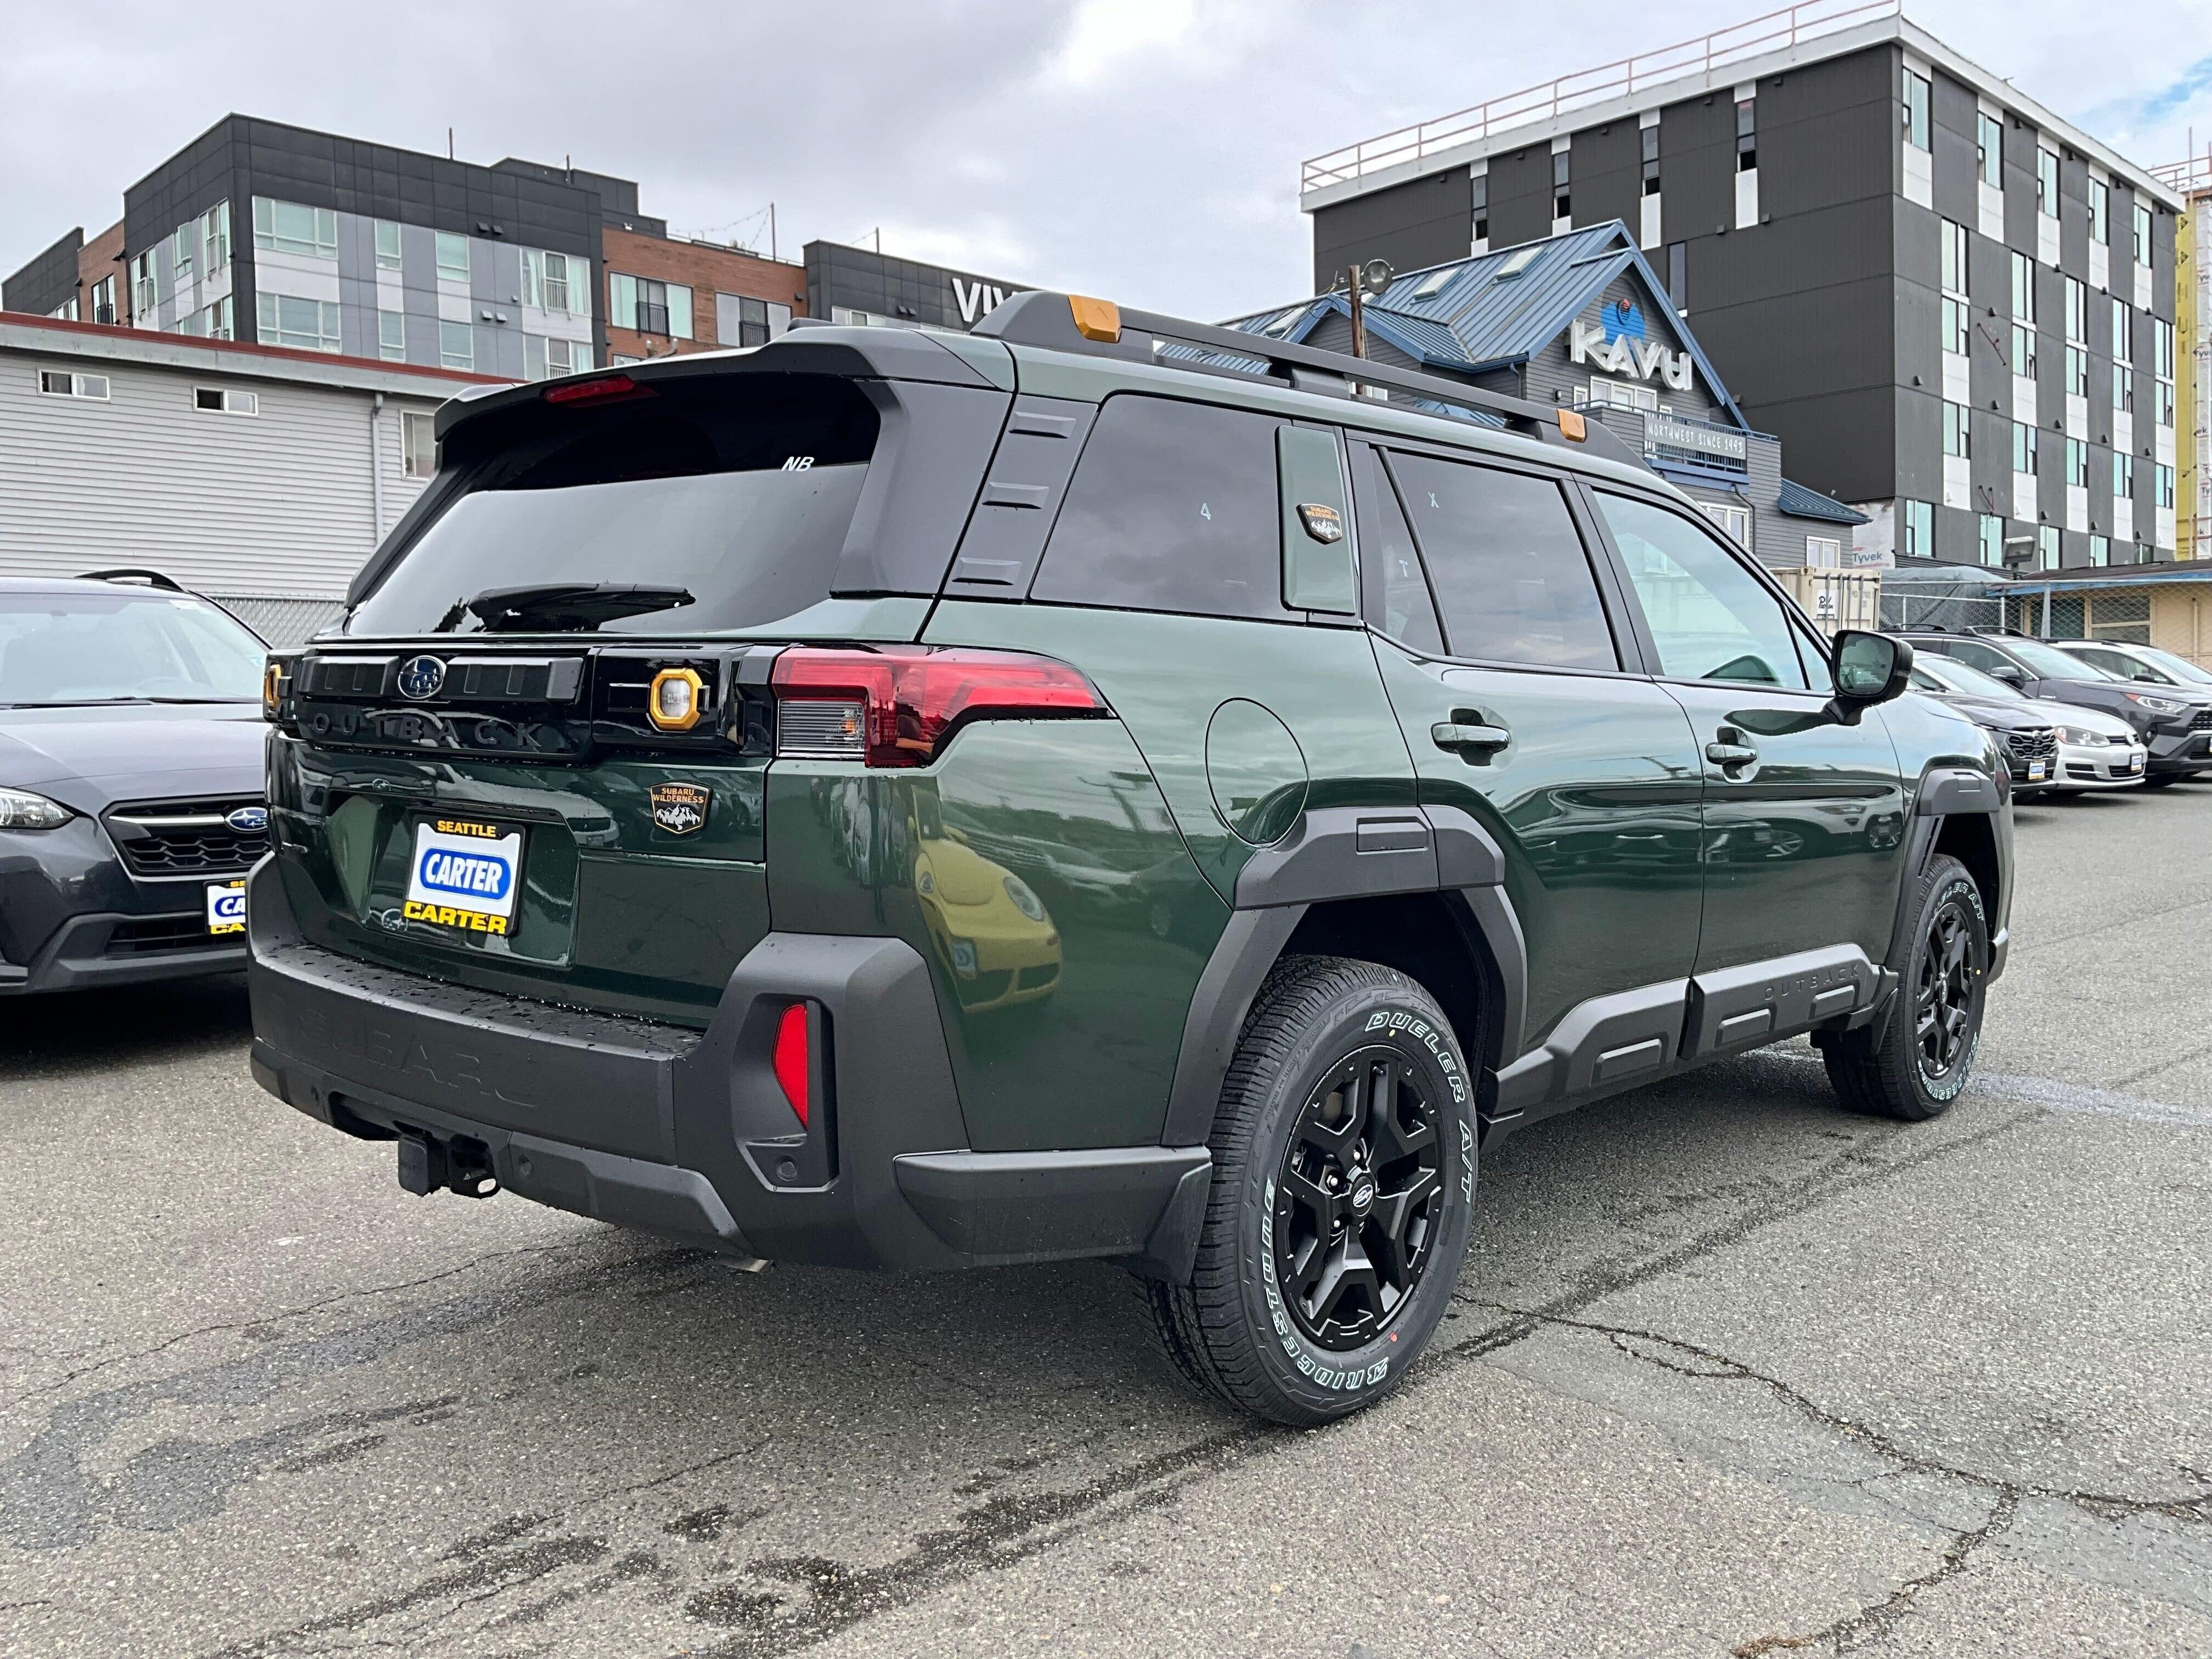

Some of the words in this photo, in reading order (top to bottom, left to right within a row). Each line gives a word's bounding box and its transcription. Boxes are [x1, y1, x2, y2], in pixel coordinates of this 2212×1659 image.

[1571, 319, 1692, 390] KAVU
[1648, 422, 1694, 443] NORTHWEST
[1698, 433, 1721, 449] SINCE
[1724, 438, 1743, 454] 1993
[781, 456, 815, 472] NB
[1305, 510, 1339, 521] WILDERNESS
[1310, 506, 1331, 514] SUBARU
[1853, 551, 1883, 564] Tyvek
[313, 712, 543, 748] OUTBACK
[652, 794, 705, 804] WILDERNESS
[661, 787, 695, 795] SUBARU
[437, 820, 496, 838] SEATTLE
[425, 853, 503, 894] CARTER
[403, 901, 507, 935] CARTER
[1764, 963, 1860, 1001] OUTBACK
[1364, 1011, 1466, 1103] DUELER
[1459, 1119, 1472, 1203] A/T
[1262, 1178, 1389, 1390] BRIDGESTONE
